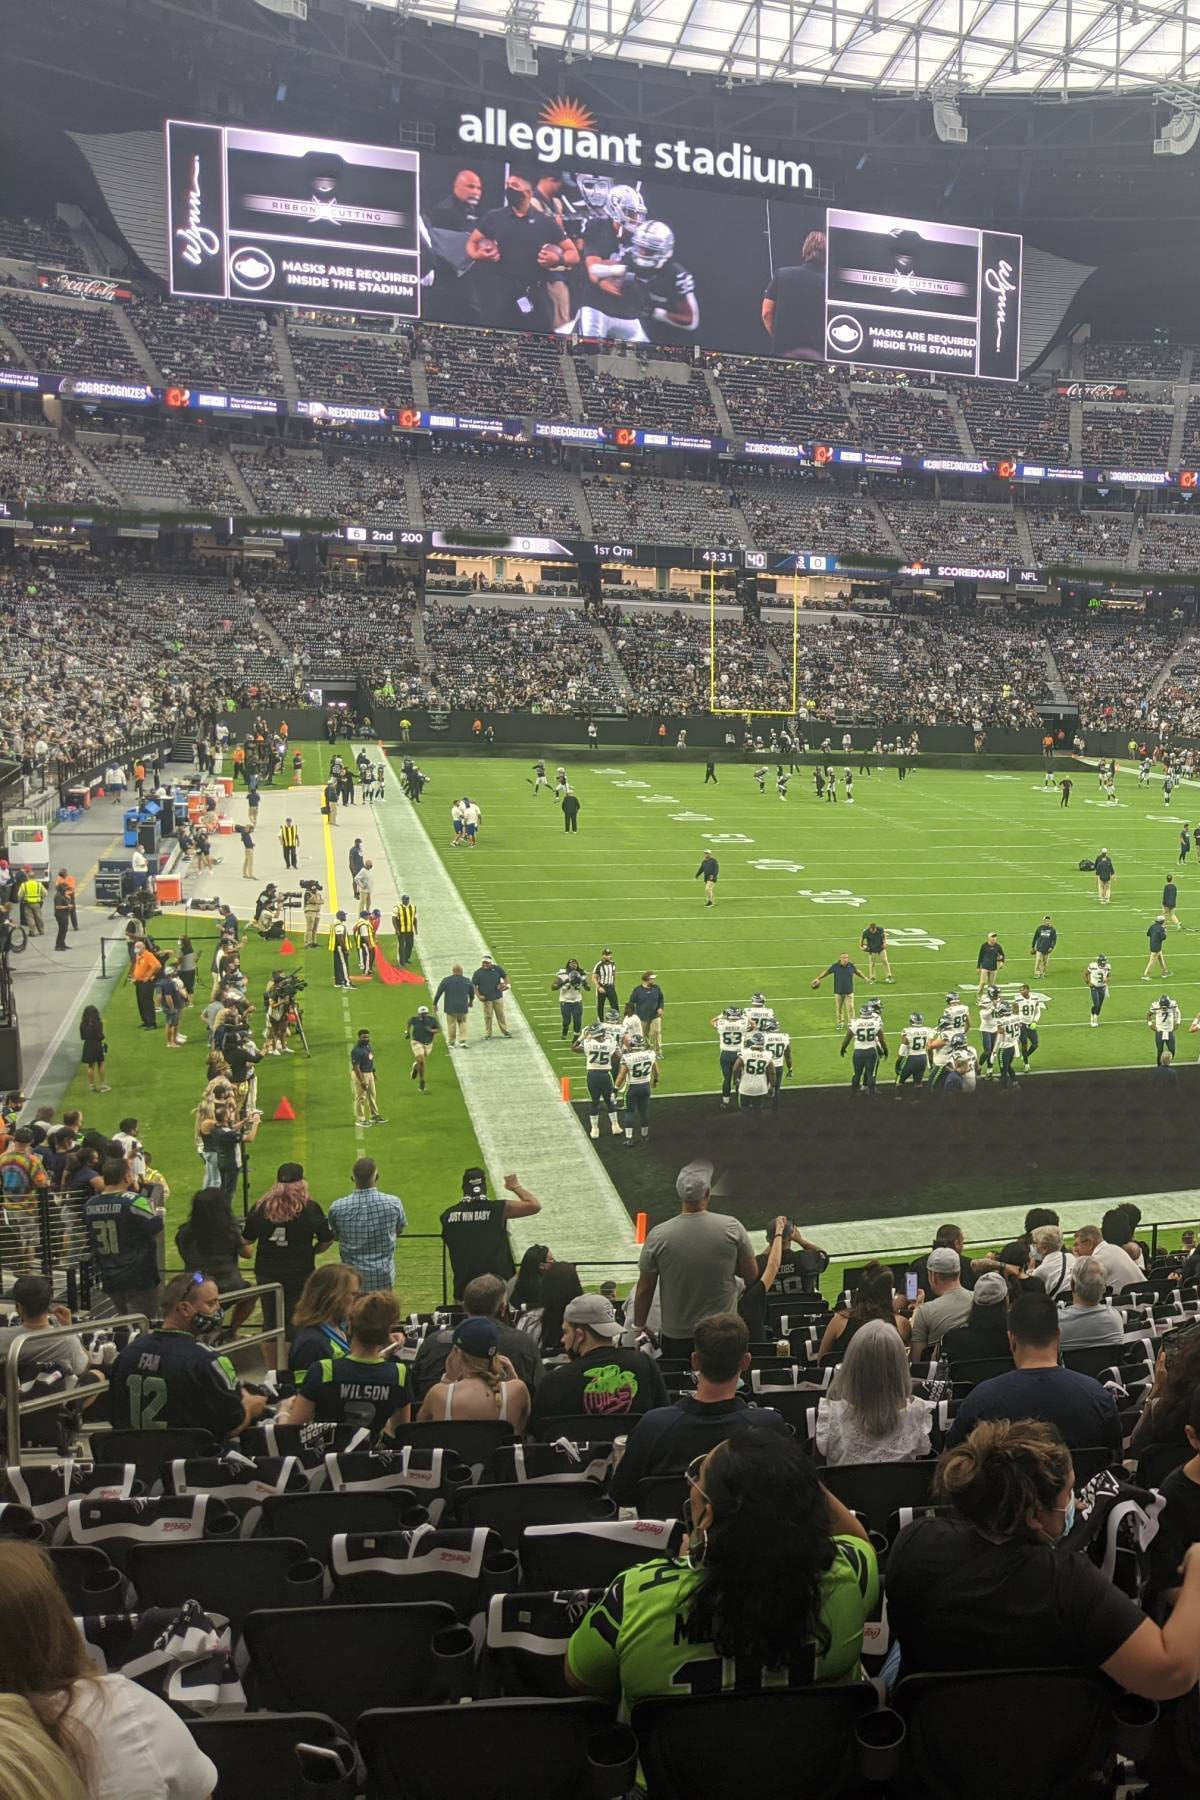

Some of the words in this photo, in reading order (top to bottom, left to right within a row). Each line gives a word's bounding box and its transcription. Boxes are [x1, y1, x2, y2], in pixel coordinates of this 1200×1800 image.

[459, 107, 643, 166] allegiant
[655, 141, 813, 189] stadium
[177, 155, 220, 266] Wynn
[272, 202, 316, 213] RIBBON
[330, 208, 382, 221] CUTTING
[282, 261, 326, 275] MASKS
[328, 265, 354, 278] ARE
[356, 268, 418, 284] REQUIRED
[288, 275, 330, 288] INSIDE
[332, 279, 356, 291] THE
[358, 281, 413, 297] STADIUM
[862, 274, 898, 285] RIBBON
[908, 280, 949, 291] CUTTING
[869, 327, 904, 339] MASKS
[905, 331, 926, 342] ARE
[927, 334, 977, 347] REQUIRED
[873, 340, 906, 351] INSIDE
[908, 343, 928, 353] THE
[929, 345, 973, 358] STADIUM
[353, 530, 360, 538] 6
[372, 530, 393, 541] 2nd
[401, 532, 423, 543] 200
[593, 545, 609, 556] 1ST
[612, 546, 633, 557] QTR
[703, 552, 733, 562] 43:31
[748, 554, 764, 566] 40
[938, 566, 1006, 579] SCOREBOARD
[1021, 572, 1038, 581] NFL
[723, 1032, 742, 1045] 63
[857, 1028, 875, 1042] 66
[913, 1036, 927, 1050] 61
[589, 1051, 610, 1065] 75
[632, 1061, 651, 1078] 62
[746, 1059, 765, 1075] 68
[448, 1211, 461, 1223] JUST
[462, 1211, 474, 1222] WIN
[474, 1210, 491, 1221] BABY
[92, 1219, 120, 1255] 31
[138, 1353, 161, 1370] FAN
[340, 1383, 390, 1401] WILSON
[126, 1373, 168, 1430] 12
